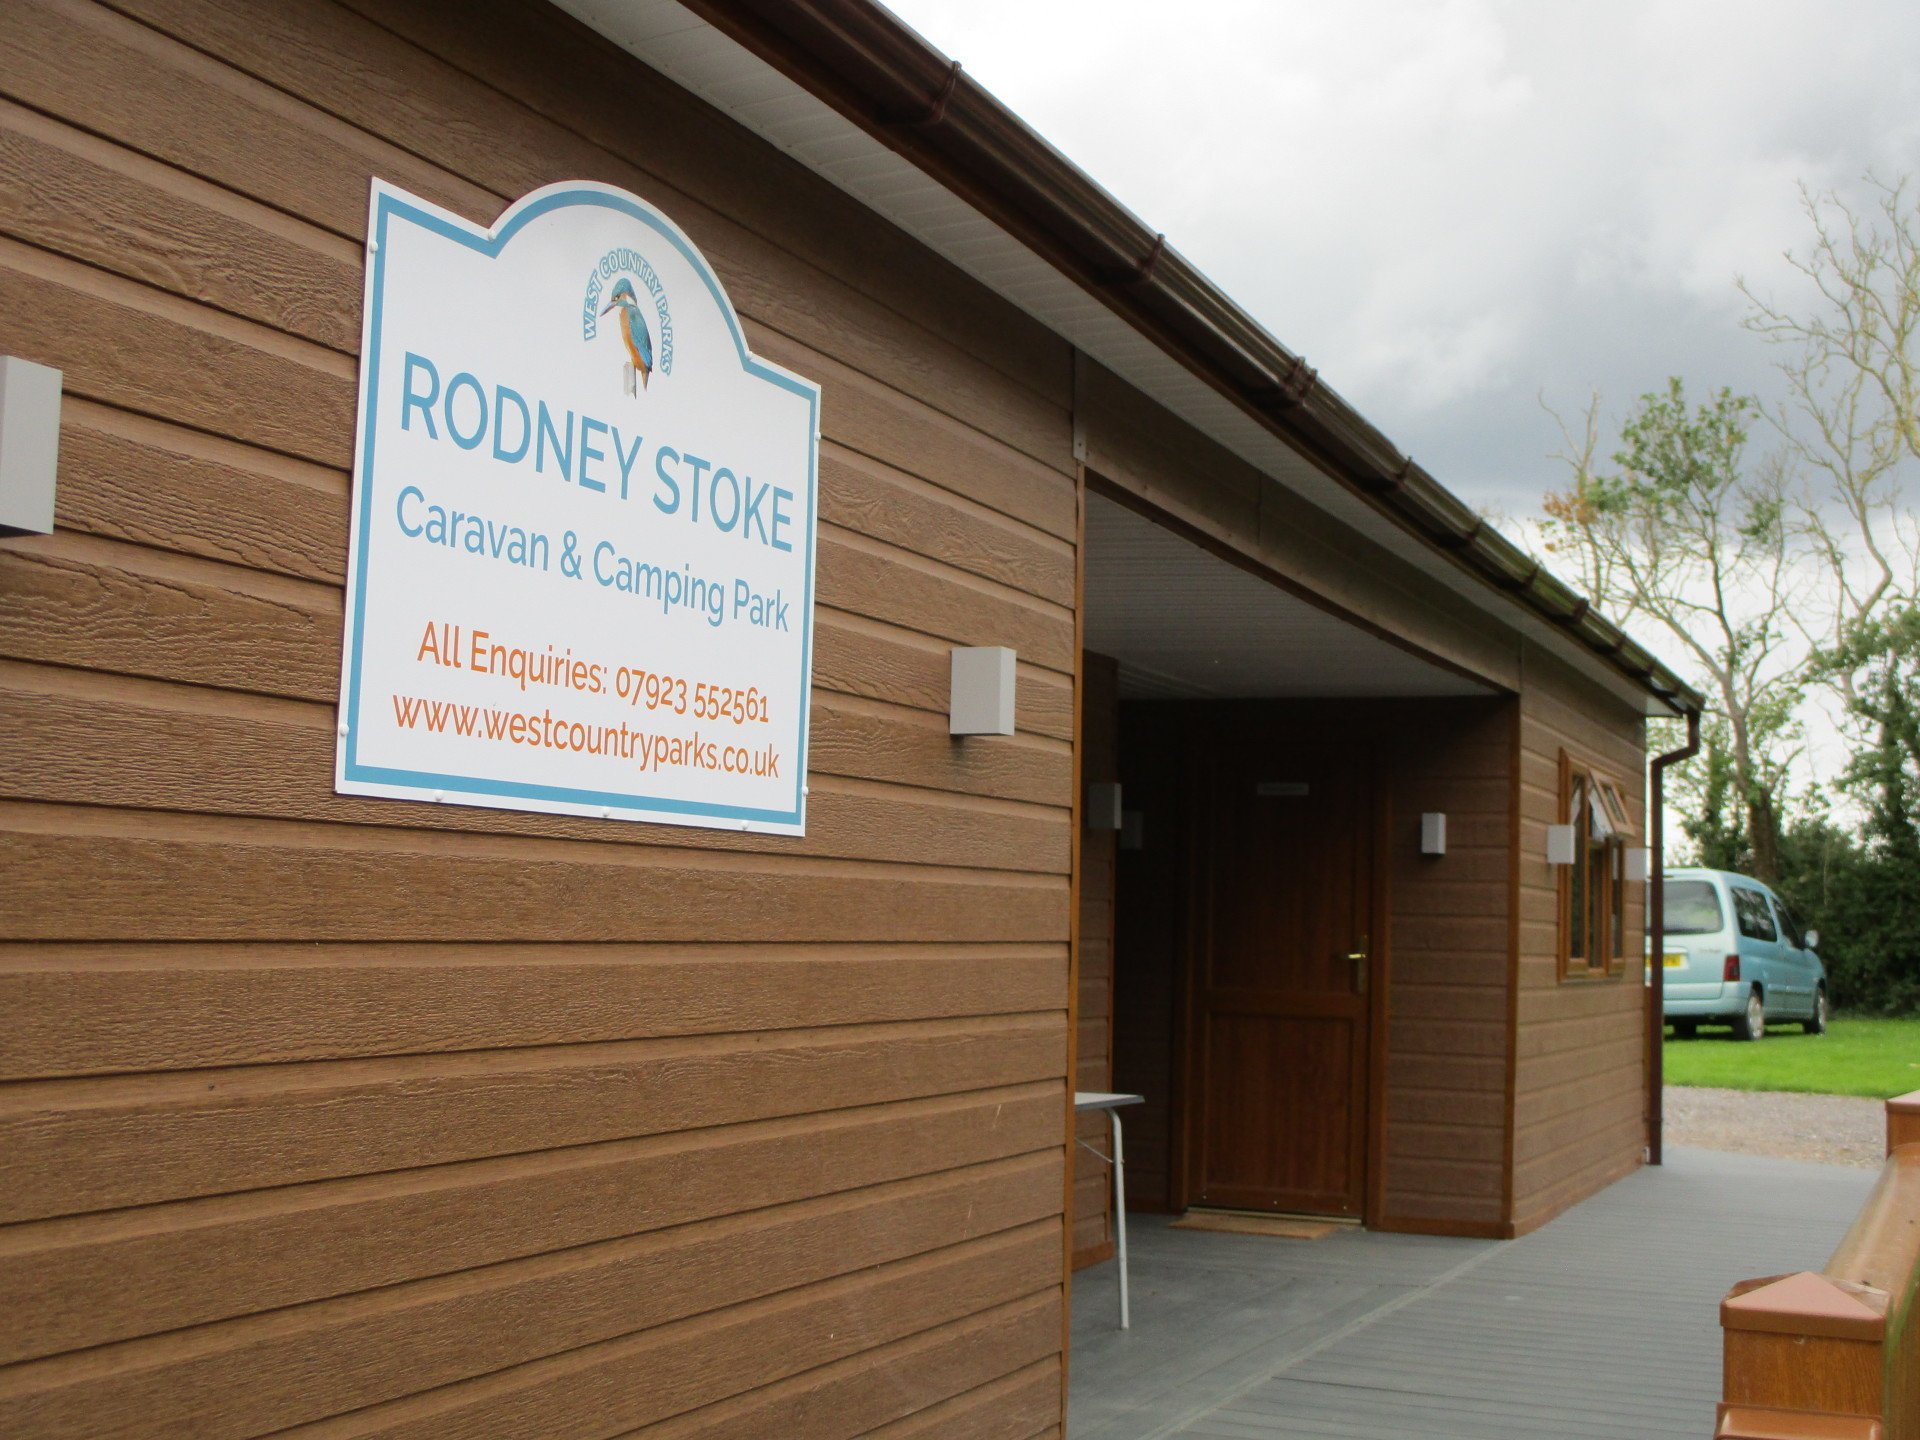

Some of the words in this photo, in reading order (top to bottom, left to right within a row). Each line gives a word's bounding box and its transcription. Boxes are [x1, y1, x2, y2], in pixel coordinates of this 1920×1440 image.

[583, 269, 602, 341] WEST
[600, 248, 663, 296] COUNTRY
[655, 294, 673, 376] PARKS
[400, 350, 644, 500] RODNEY
[652, 445, 795, 553] STOKE
[396, 484, 550, 572] Caravan
[559, 530, 583, 580] &
[592, 540, 725, 628] Camping
[734, 578, 790, 633] Park
[392, 694, 781, 779] www.westcountryparks.co.uk
[416, 620, 463, 669] All
[470, 630, 608, 696] Enquiries:
[615, 665, 688, 716] 07923
[694, 681, 770, 725] 552561
